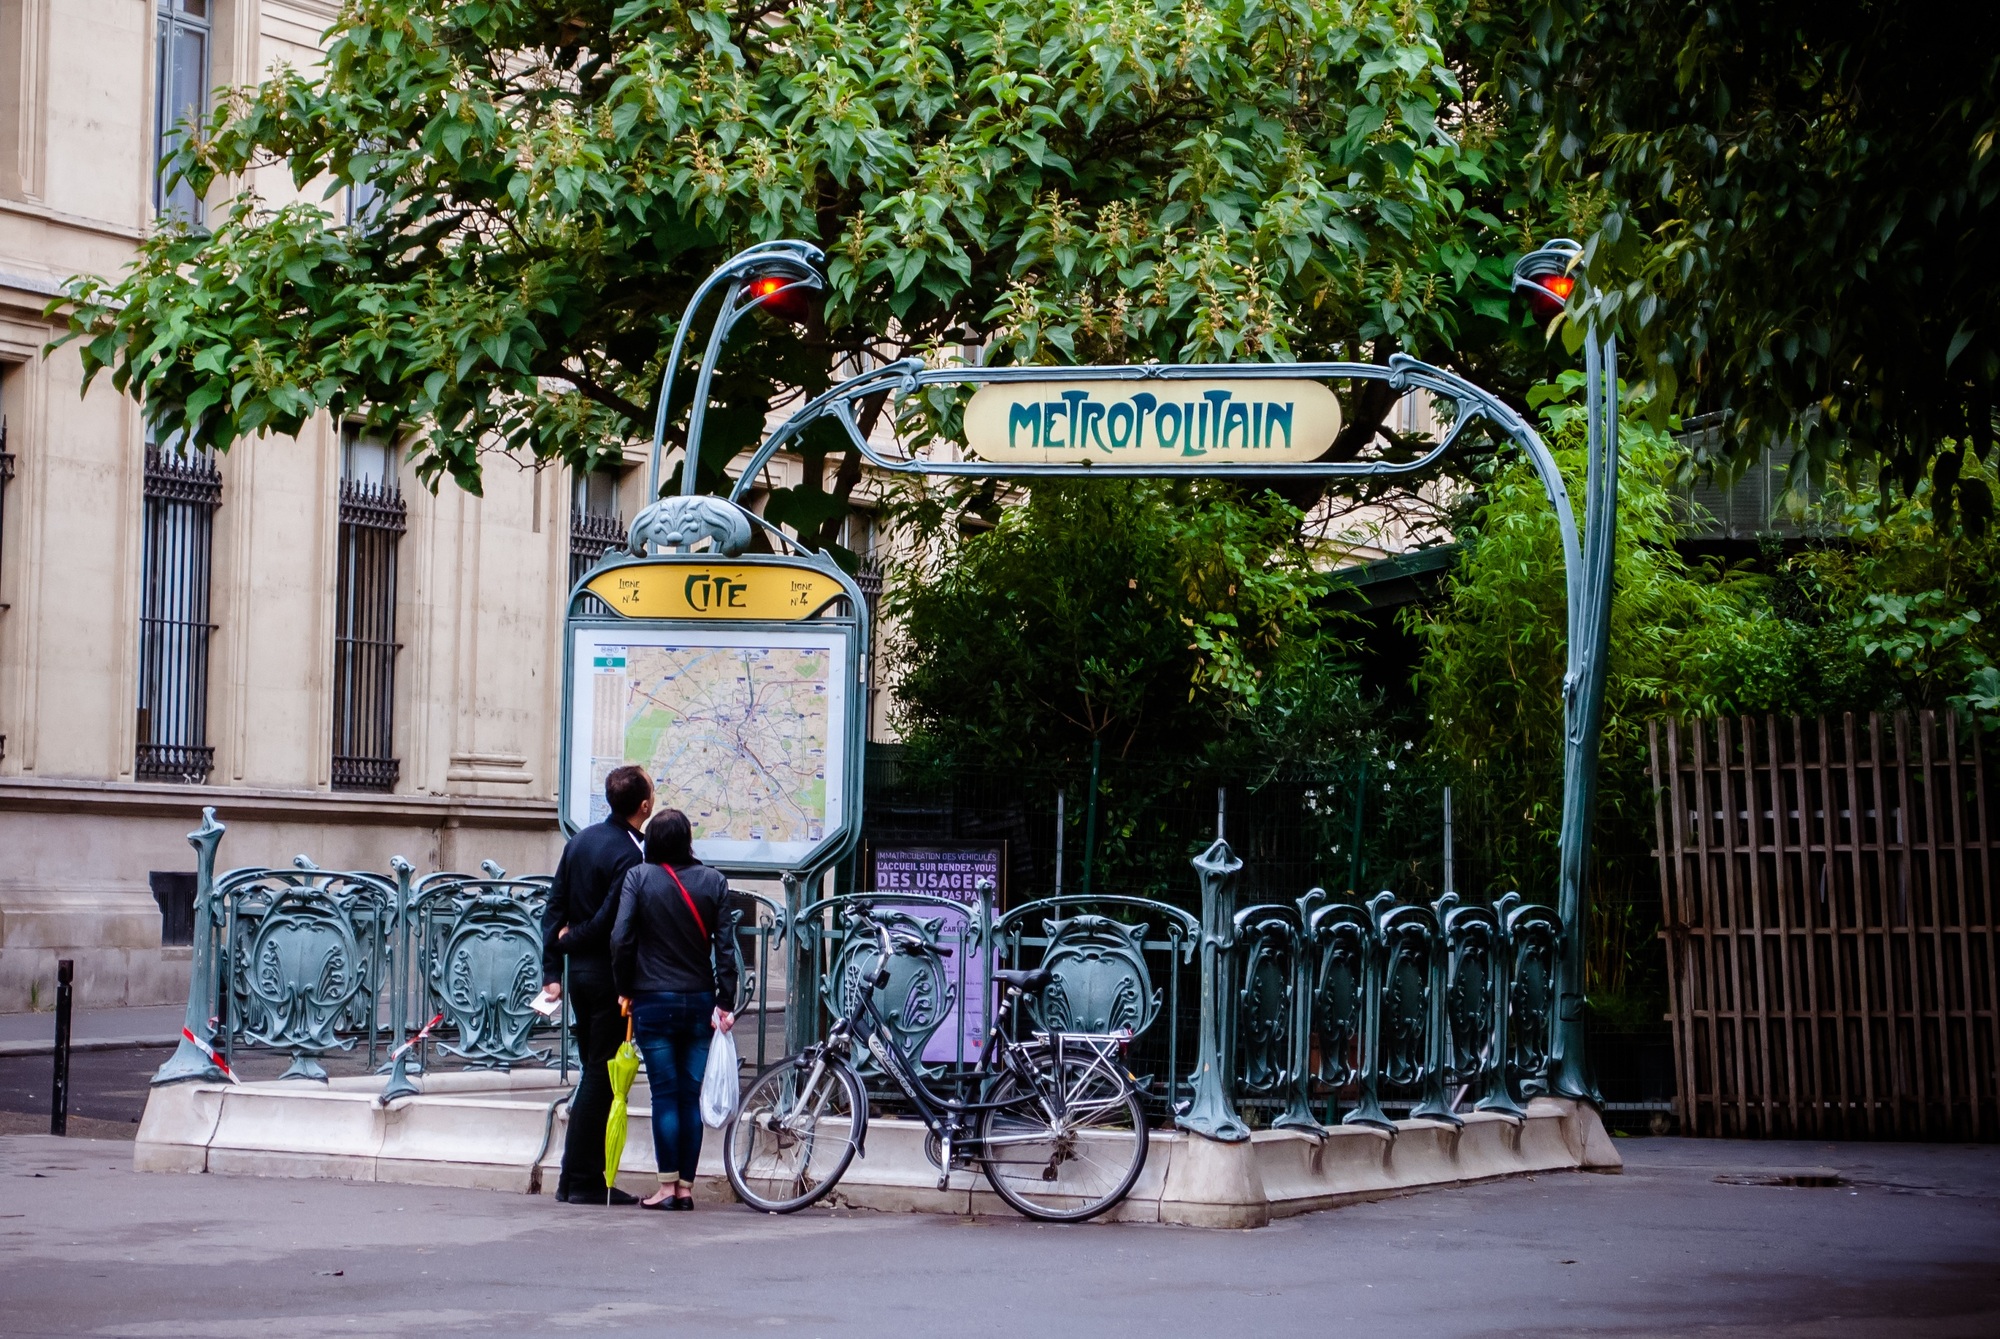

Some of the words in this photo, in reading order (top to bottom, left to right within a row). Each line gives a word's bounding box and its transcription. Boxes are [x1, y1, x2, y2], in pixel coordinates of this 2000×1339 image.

[1009, 390, 1294, 457] METROPOLITAIN
[619, 578, 640, 589] LIGNE
[790, 581, 812, 591] LIGNE
[631, 590, 640, 603] 4
[684, 569, 748, 612] CITÉ
[800, 592, 808, 605] 4
[877, 852, 940, 860] IMMATRICULATION
[877, 862, 918, 871] L'ACCUEIL
[920, 863, 936, 871] SUR
[938, 863, 997, 872] RENDEZ-VOUS
[877, 872, 911, 888] DES
[942, 890, 962, 900] PAS
